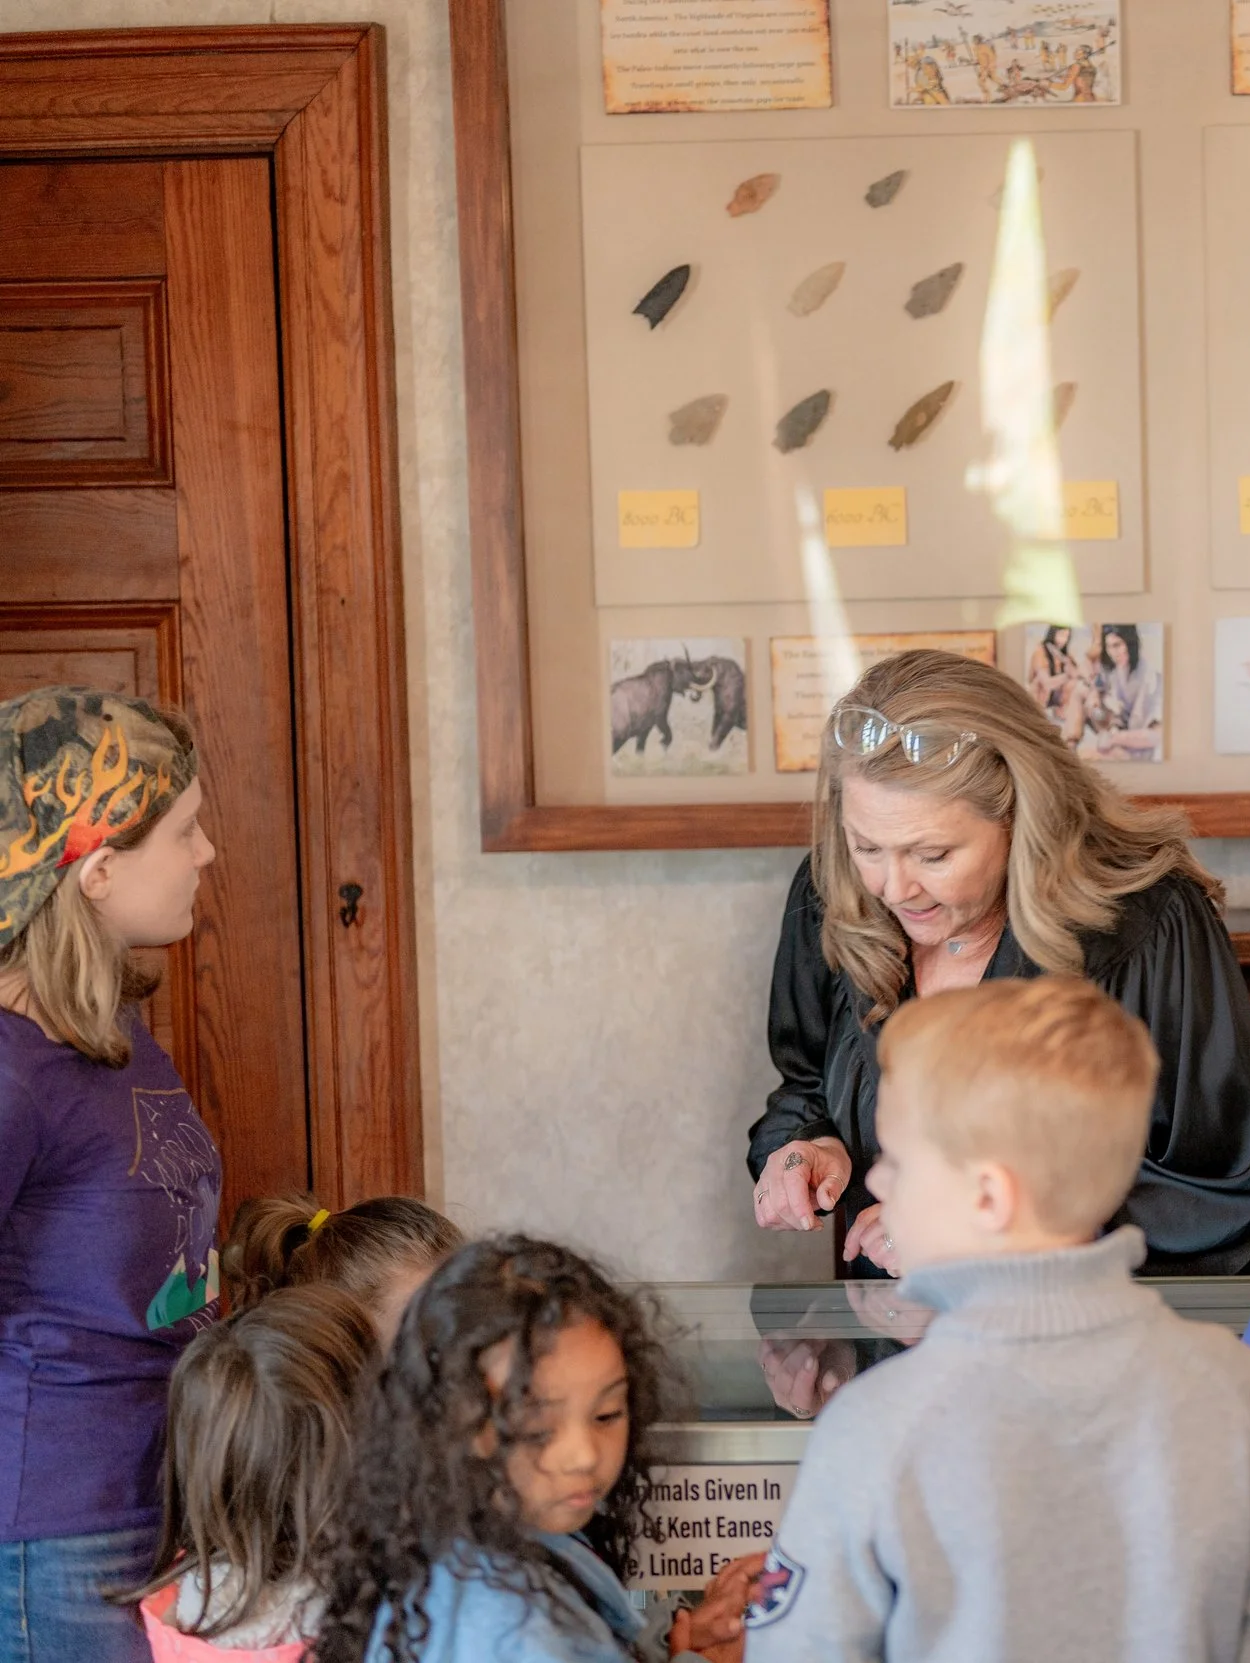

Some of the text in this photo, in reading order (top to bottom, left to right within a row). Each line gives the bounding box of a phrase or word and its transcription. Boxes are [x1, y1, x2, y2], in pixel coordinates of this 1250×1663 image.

[705, 1478, 758, 1501] Given
[764, 1478, 781, 1500] In
[668, 1516, 712, 1539] Kent
[717, 1516, 774, 1539] Eanes
[650, 1552, 703, 1577] Linda
